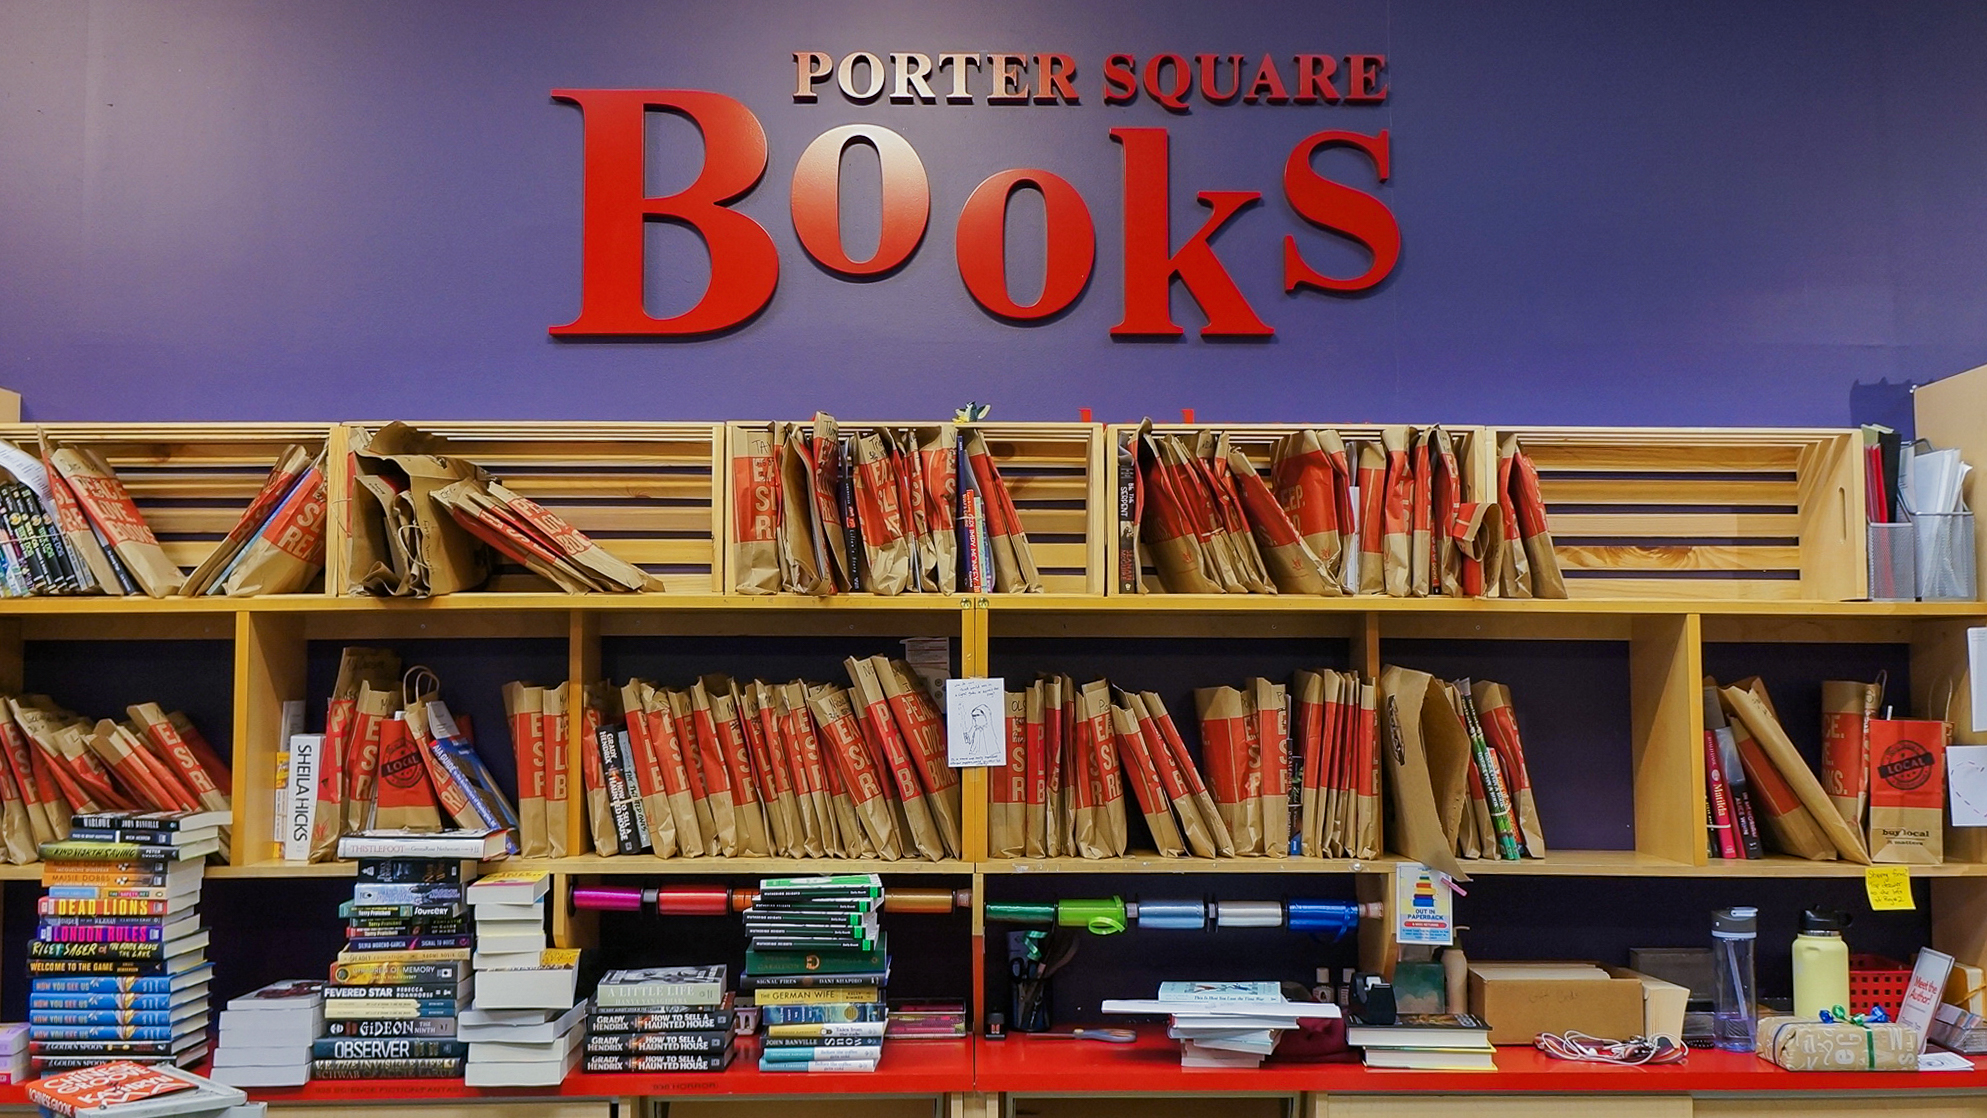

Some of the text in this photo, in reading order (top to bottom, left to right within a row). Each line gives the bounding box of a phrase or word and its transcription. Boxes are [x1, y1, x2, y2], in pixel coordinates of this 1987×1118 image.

[792, 51, 1389, 112] PORTER SQUARE
[970, 547, 979, 587] MONKEY
[600, 731, 612, 764] HENDRIX
[607, 733, 617, 759] GRADY
[386, 755, 419, 771] LOCAL
[433, 744, 457, 772] AIA GUIDE
[1887, 758, 1926, 774] LOCAL
[294, 745, 312, 841] SHEILA HICKS
[1713, 784, 1726, 816] Matilda
[616, 781, 632, 836] HOW SELL A
[1736, 797, 1744, 816] ALICE
[616, 815, 628, 840] HOUSE
[1882, 829, 1901, 838] buy
[58, 900, 148, 915] DEAD LIONS
[52, 927, 147, 942] LONDON RULES
[32, 942, 97, 956] RILEY SAGER
[30, 962, 113, 971] WELCOME TO THE GAME
[608, 986, 695, 997] A LITTLE LIFE
[1915, 976, 1929, 991] Meet
[324, 988, 366, 997] FEVERED
[368, 988, 392, 997] STAR
[772, 992, 811, 1000] GERMAN
[814, 990, 835, 998] WIFE
[50, 1000, 62, 1008] YOU
[644, 1019, 715, 1029] HAUNTED HOUSE
[334, 1041, 409, 1059] OBSERVER
[335, 1060, 357, 1069] THE
[57, 1066, 150, 1094] GROOVE
